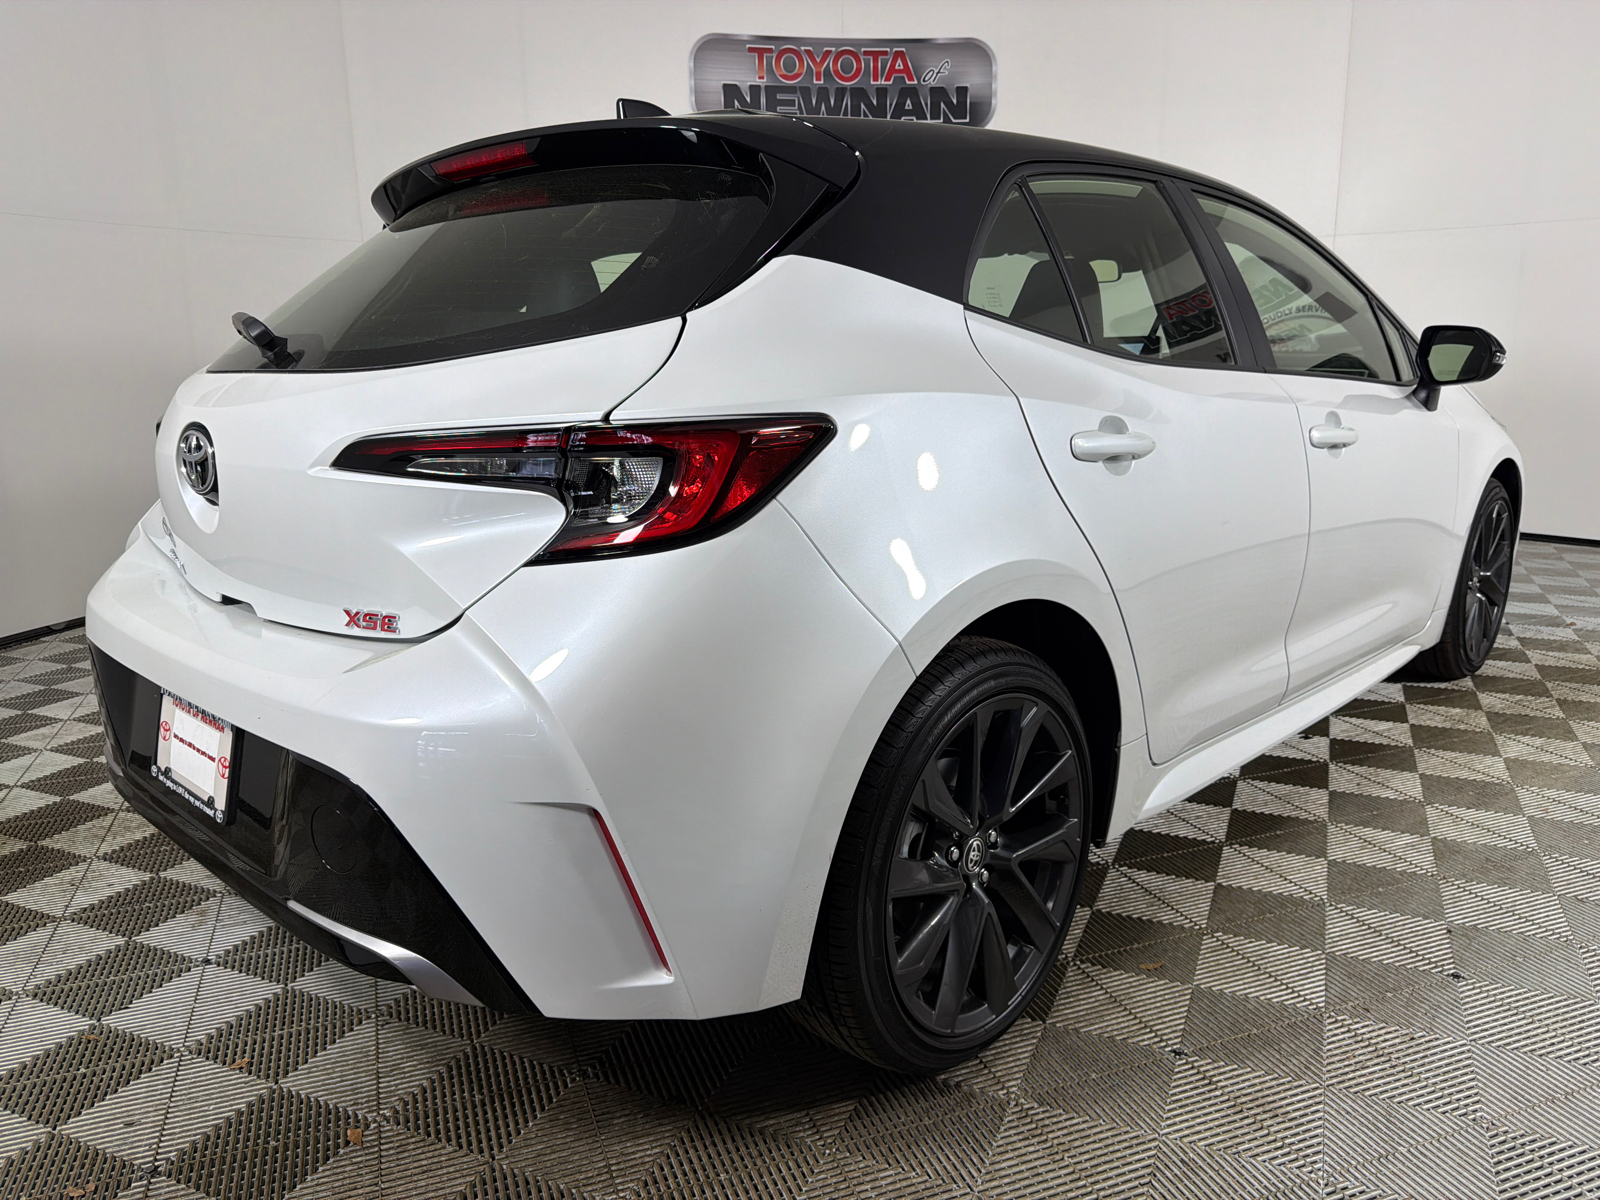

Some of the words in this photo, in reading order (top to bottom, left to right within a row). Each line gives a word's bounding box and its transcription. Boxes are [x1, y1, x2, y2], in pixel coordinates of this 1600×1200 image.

[746, 44, 916, 85] TOYOTA
[920, 59, 951, 85] of
[721, 82, 970, 123] NEWNAN
[342, 606, 401, 635] XSE
